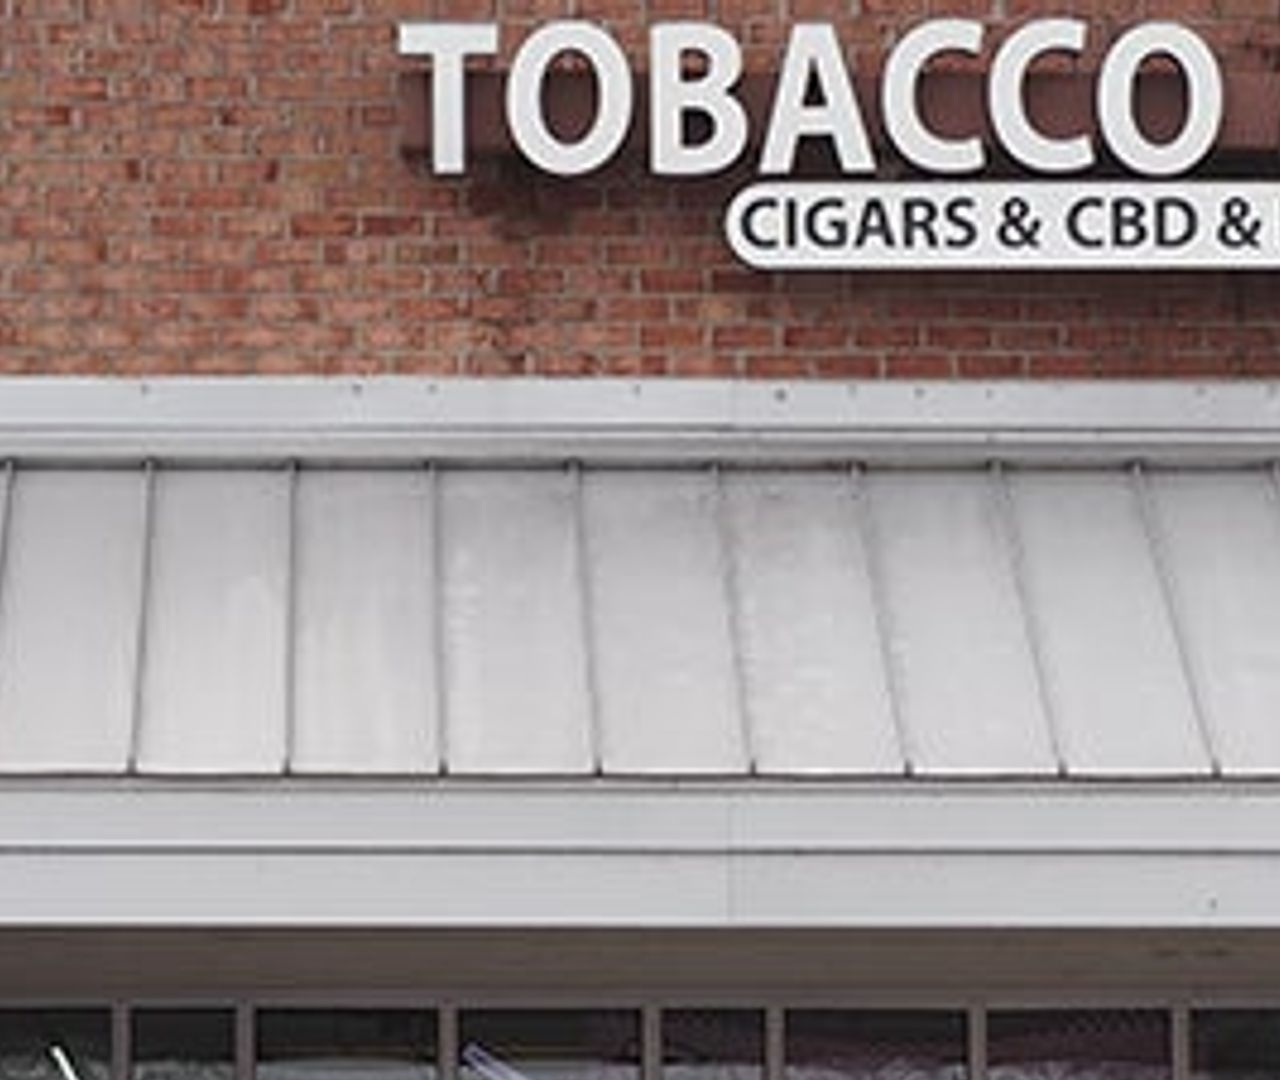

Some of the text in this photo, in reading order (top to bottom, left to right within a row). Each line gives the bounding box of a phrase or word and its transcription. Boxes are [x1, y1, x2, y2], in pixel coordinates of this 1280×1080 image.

[397, 18, 1223, 176] TOBACCO
[738, 196, 977, 249] CIGARS
[996, 197, 1043, 248] &
[1065, 197, 1199, 249] CBD
[1217, 197, 1263, 248] &
